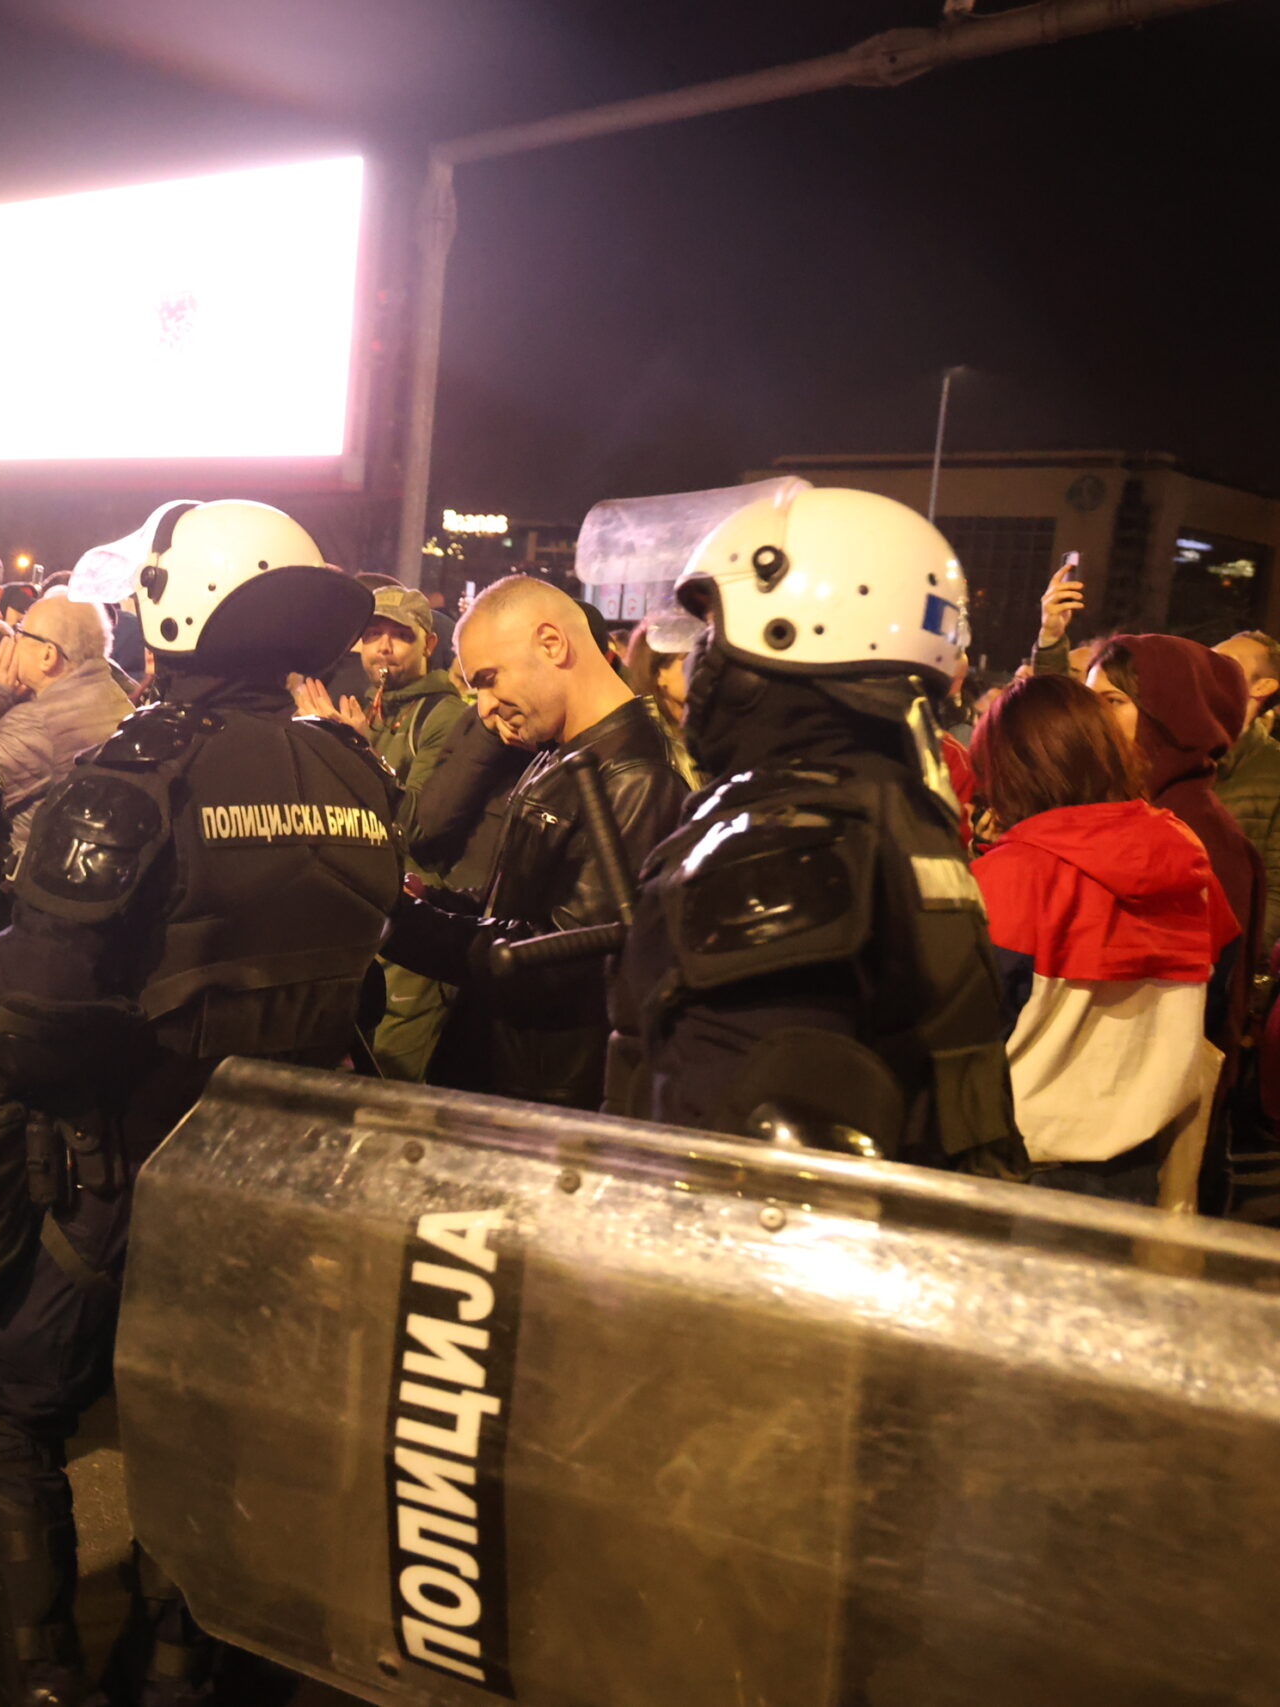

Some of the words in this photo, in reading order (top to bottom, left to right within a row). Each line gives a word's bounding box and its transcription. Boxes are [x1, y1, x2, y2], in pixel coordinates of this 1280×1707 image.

[202, 804, 325, 842] ПОЛИЦИЈСКА
[324, 804, 389, 846] БРИГАДА
[393, 1208, 504, 1683] ПОЛИЦИЈА
